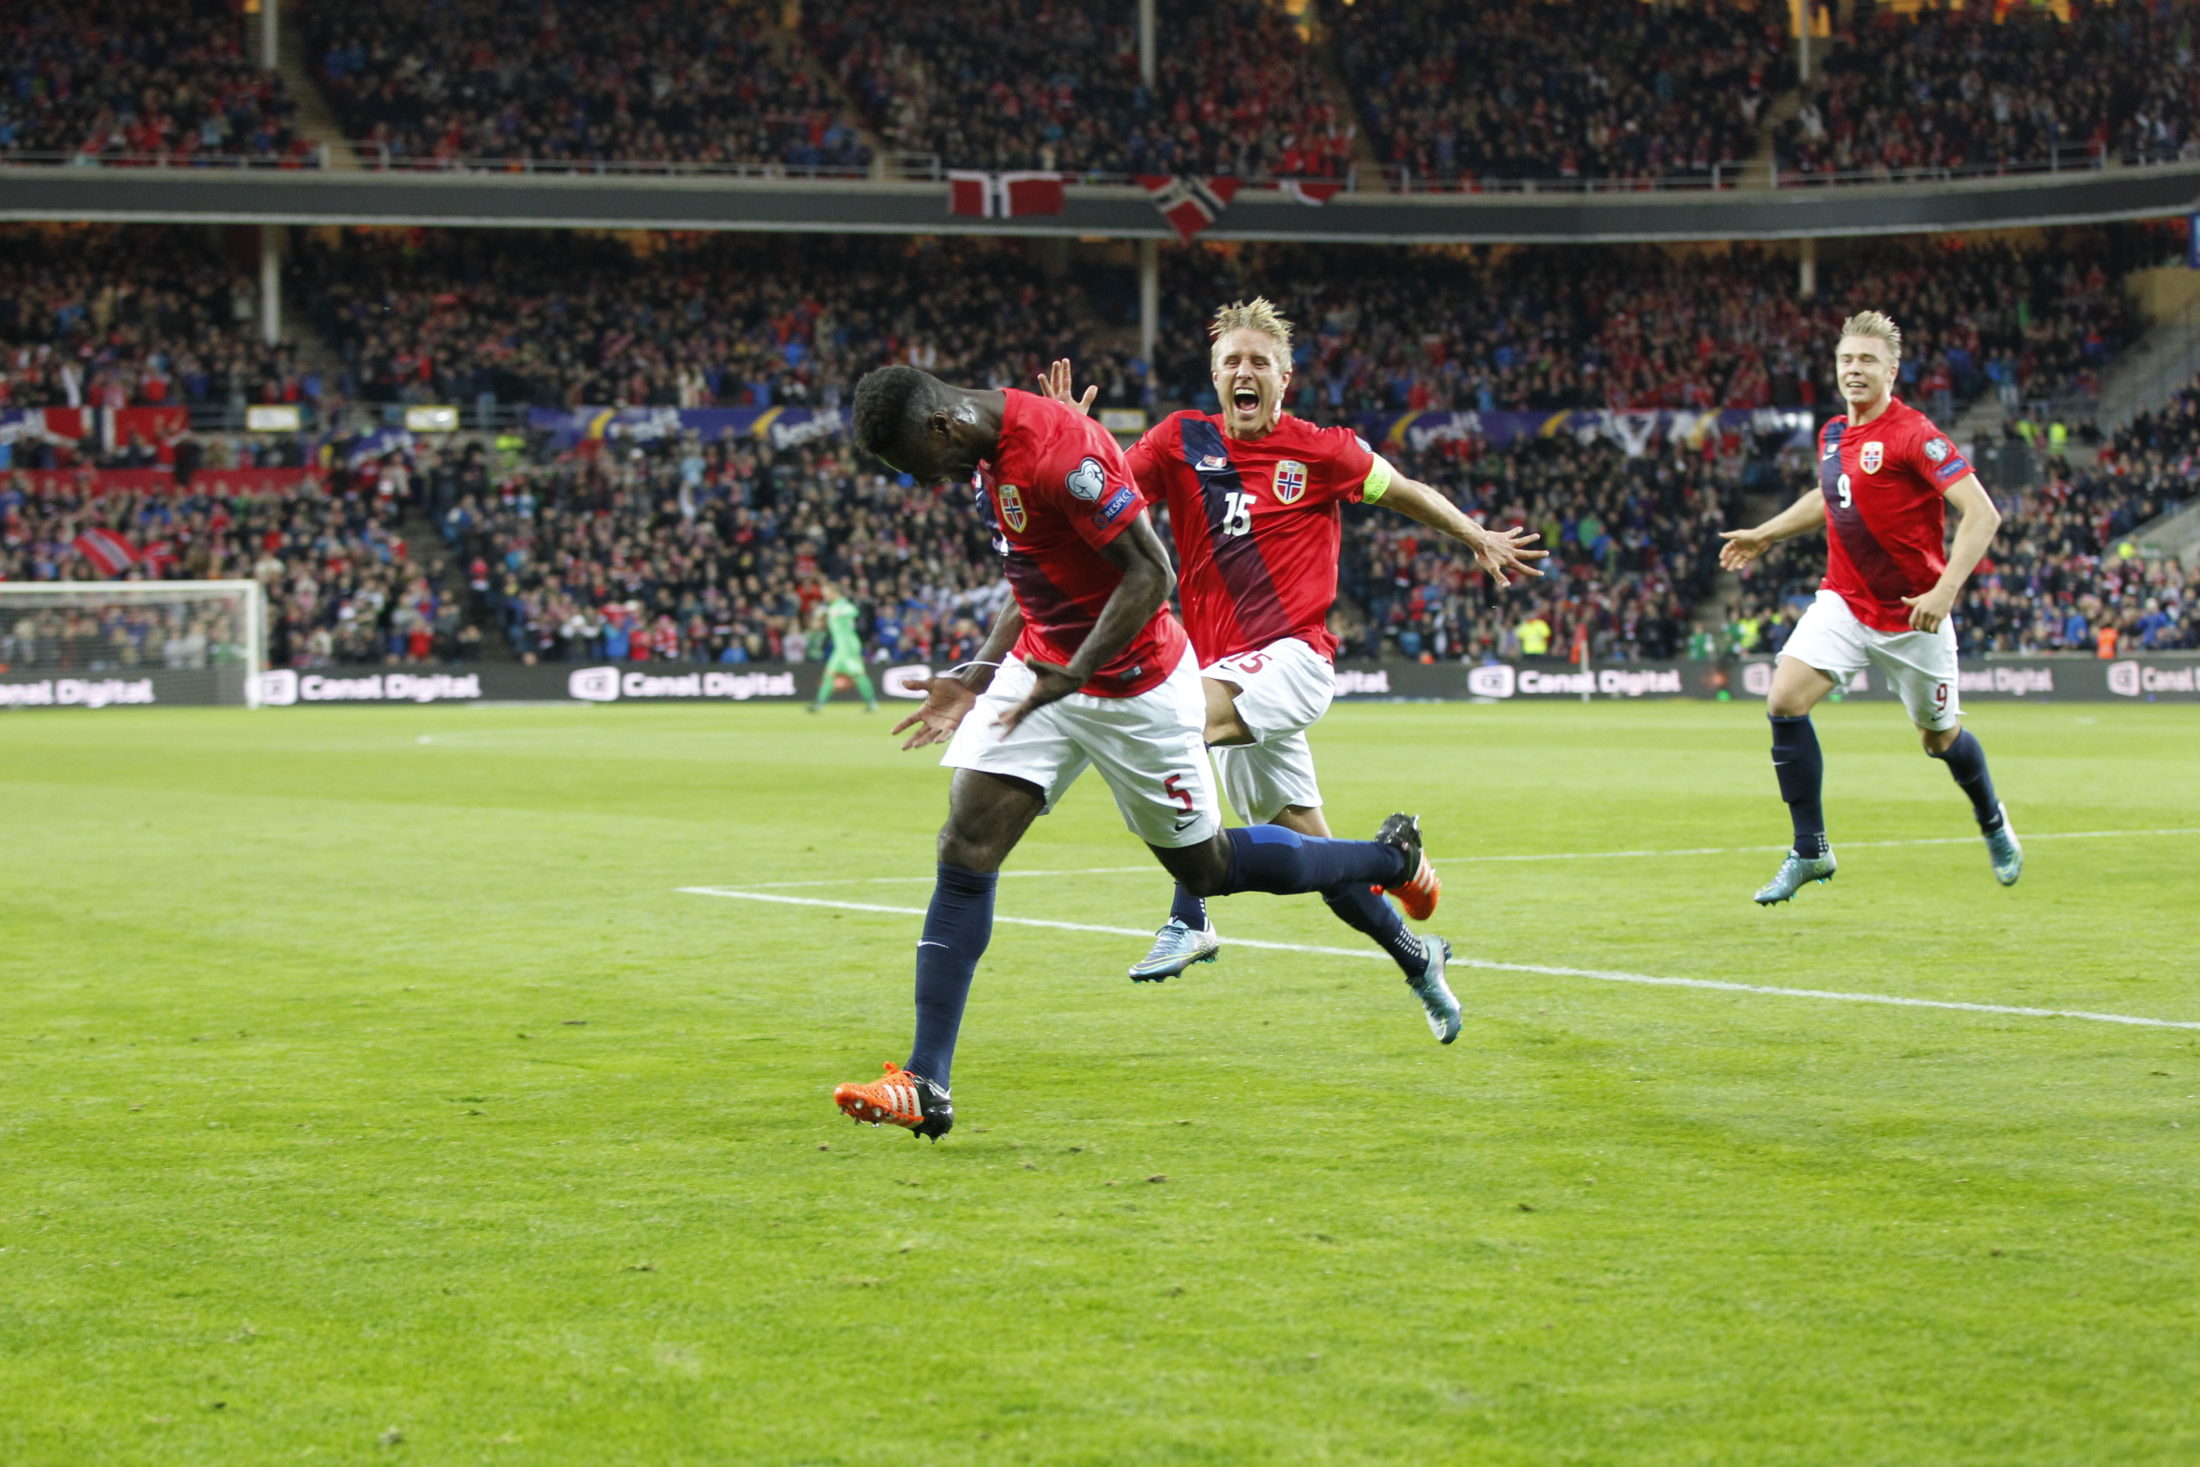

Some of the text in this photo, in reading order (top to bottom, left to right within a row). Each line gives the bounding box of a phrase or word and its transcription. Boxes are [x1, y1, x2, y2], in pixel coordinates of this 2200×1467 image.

[1104, 488, 1135, 519] RESPECT
[1837, 473, 1852, 509] 9
[1223, 492, 1257, 537] 15
[55, 677, 155, 708] Digital
[301, 673, 482, 702] Canal Digital
[622, 671, 796, 700] Canal Digital
[1518, 668, 1682, 696] Canal Digital
[1995, 666, 2054, 696] Digital
[2142, 666, 2194, 692] Canal
[1936, 683, 1948, 711] 9
[1163, 773, 1194, 815] 5
